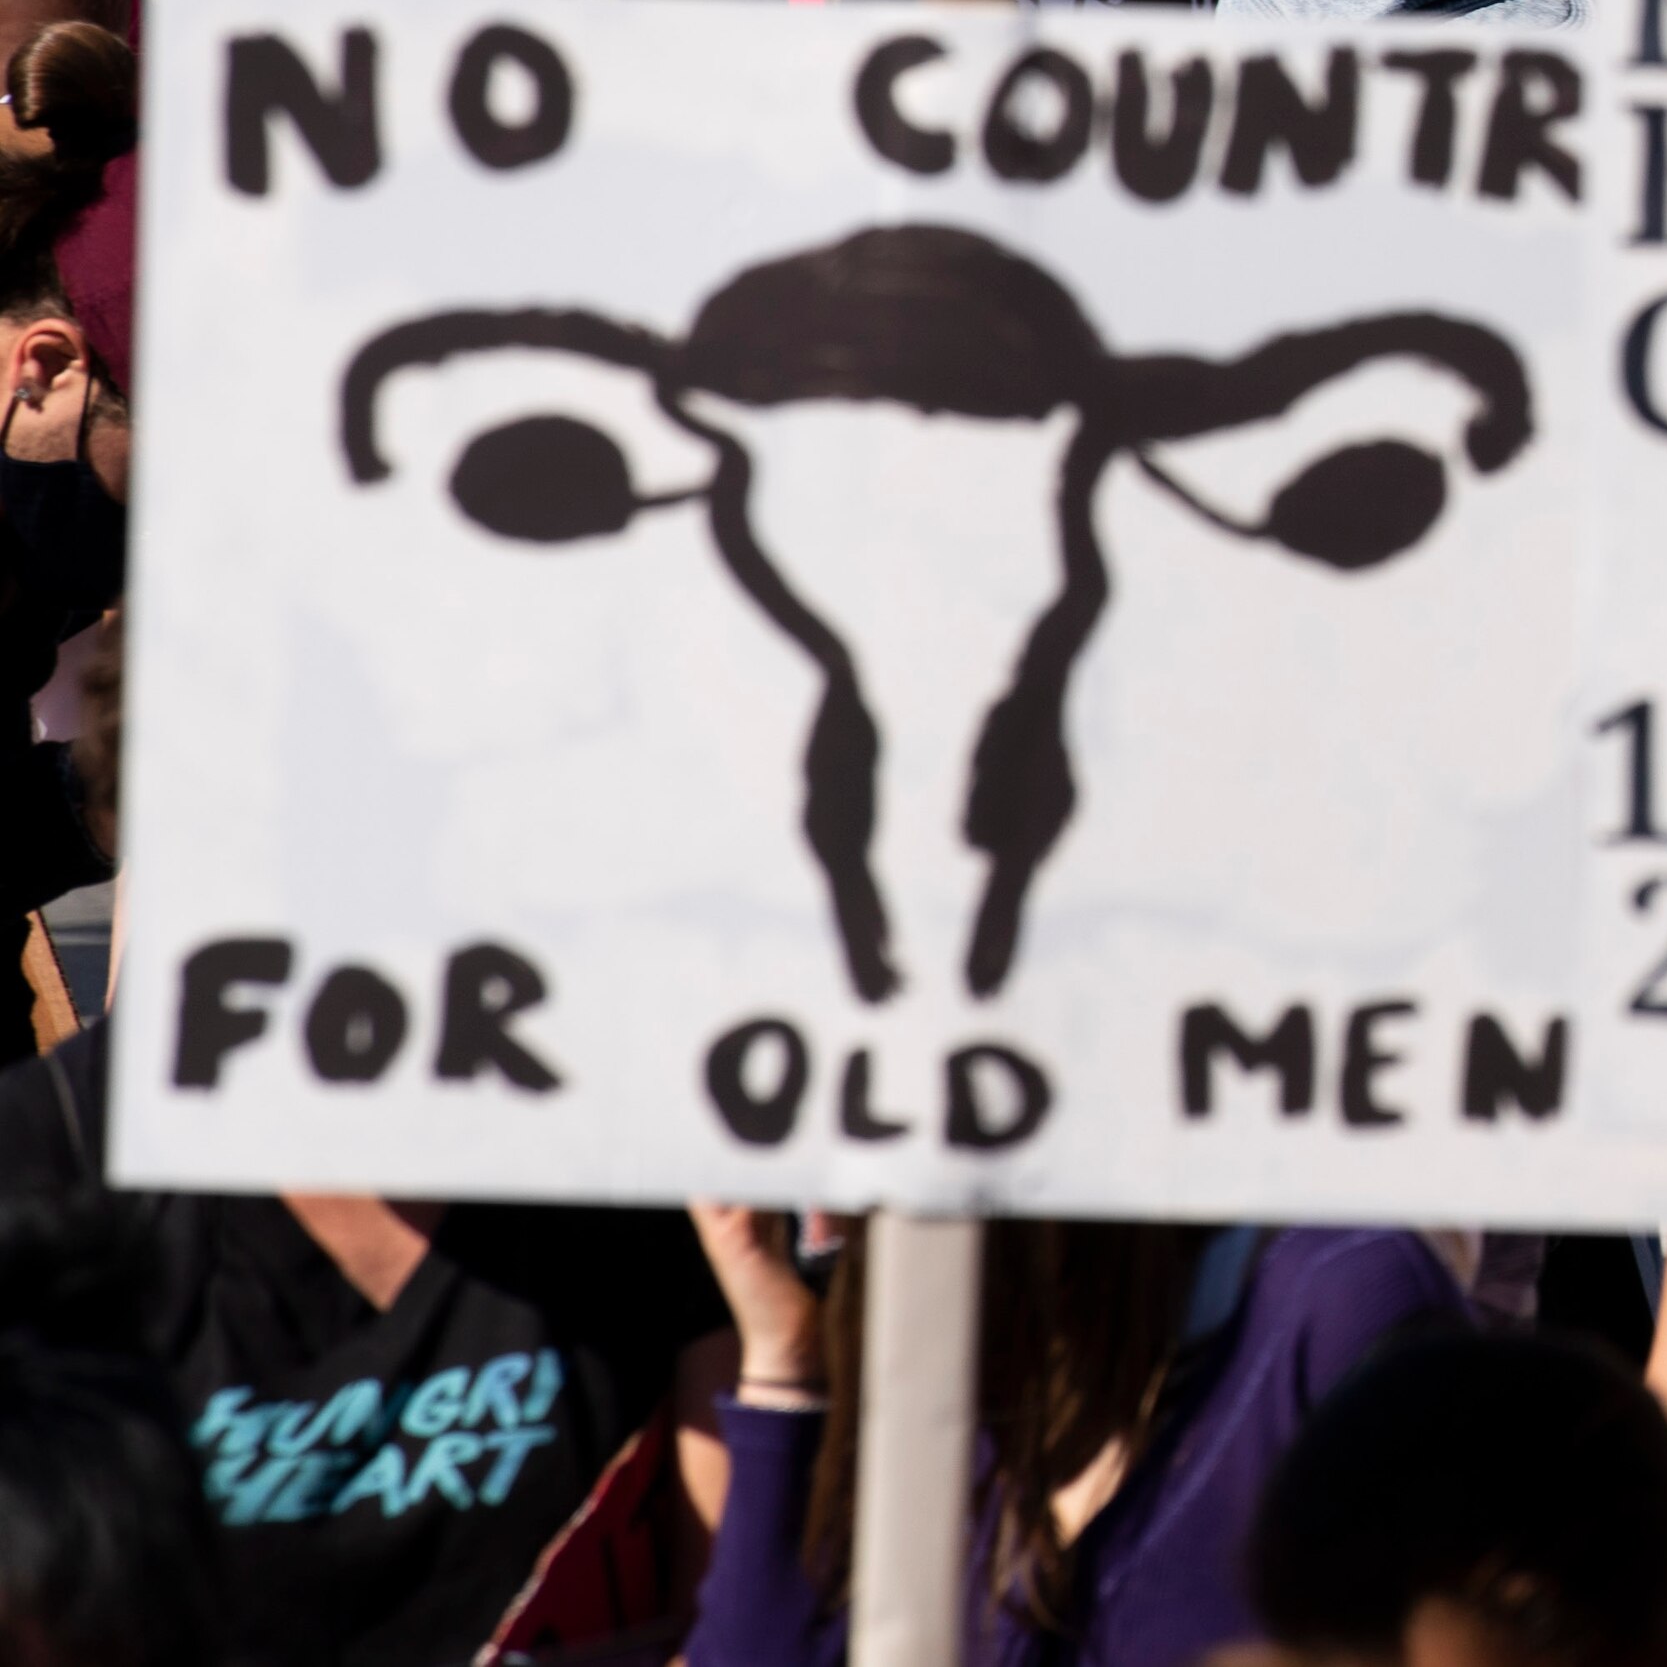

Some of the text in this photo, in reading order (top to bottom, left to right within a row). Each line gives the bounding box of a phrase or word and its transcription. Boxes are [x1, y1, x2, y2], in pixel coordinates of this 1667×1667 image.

[225, 22, 1583, 205] NO COUNTR
[170, 936, 1571, 1153] FOR OLD MEN
[206, 1426, 558, 1526] HEART
